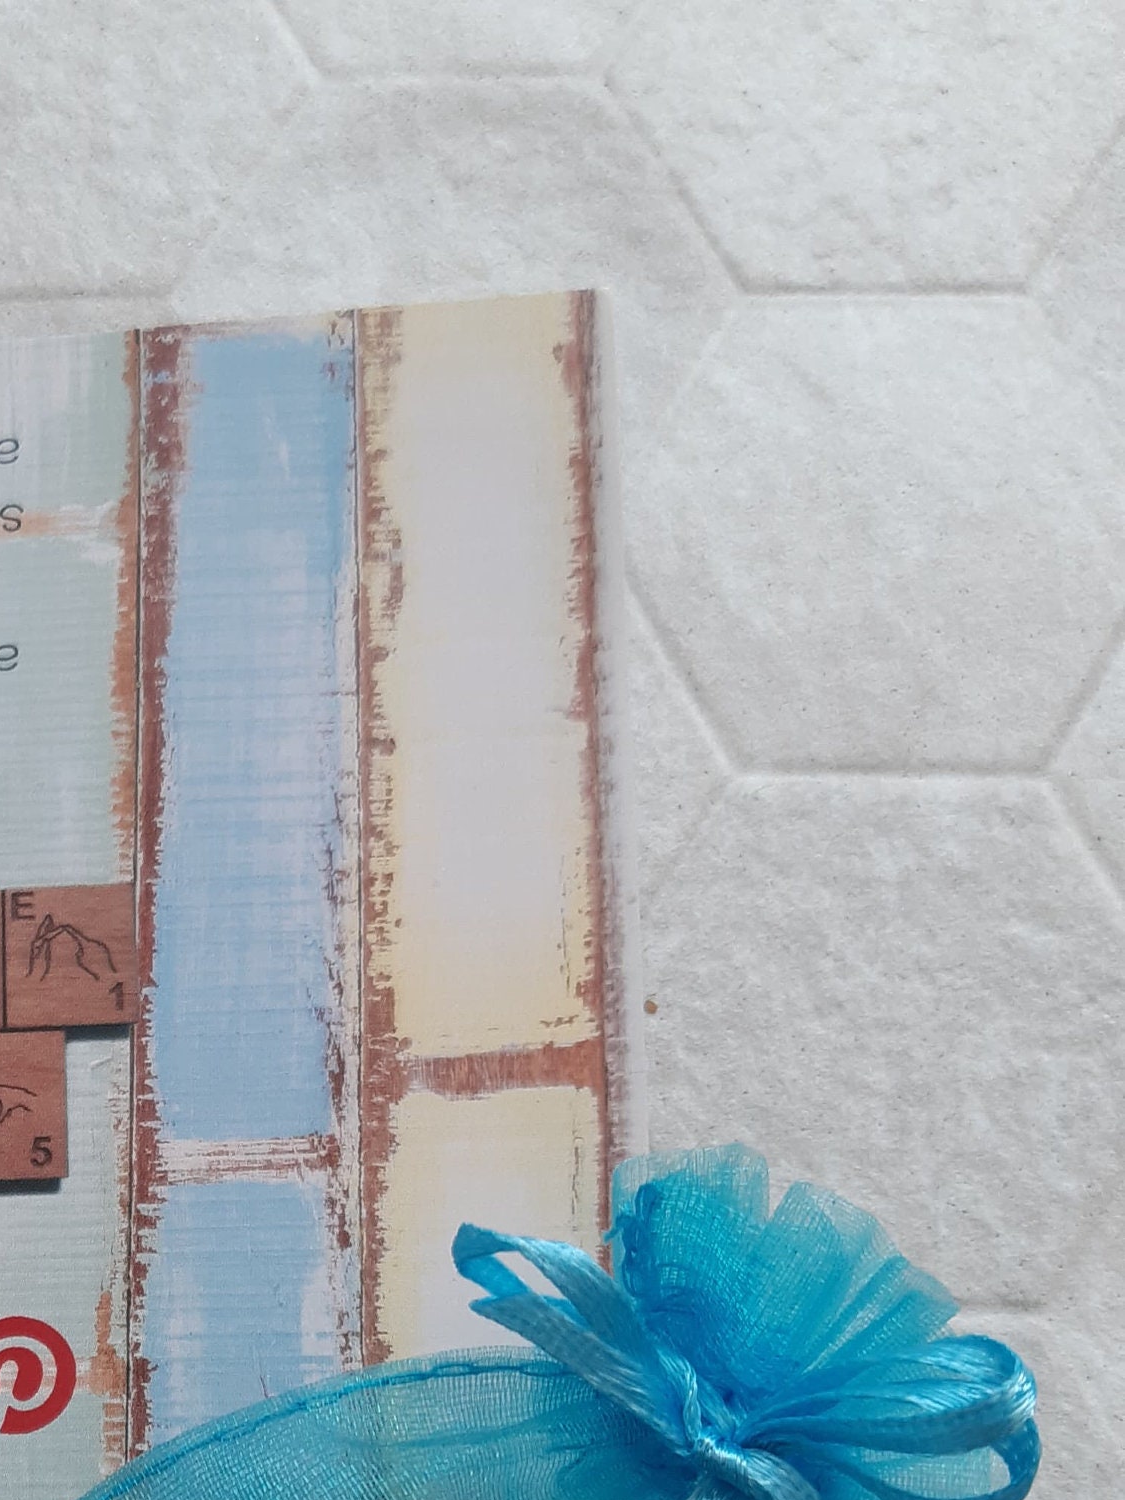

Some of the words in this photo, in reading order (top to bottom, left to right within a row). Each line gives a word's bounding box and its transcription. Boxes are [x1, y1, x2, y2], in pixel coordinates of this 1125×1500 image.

[11, 892, 36, 920] E
[110, 981, 125, 1010] 1
[30, 1136, 53, 1166] 5
